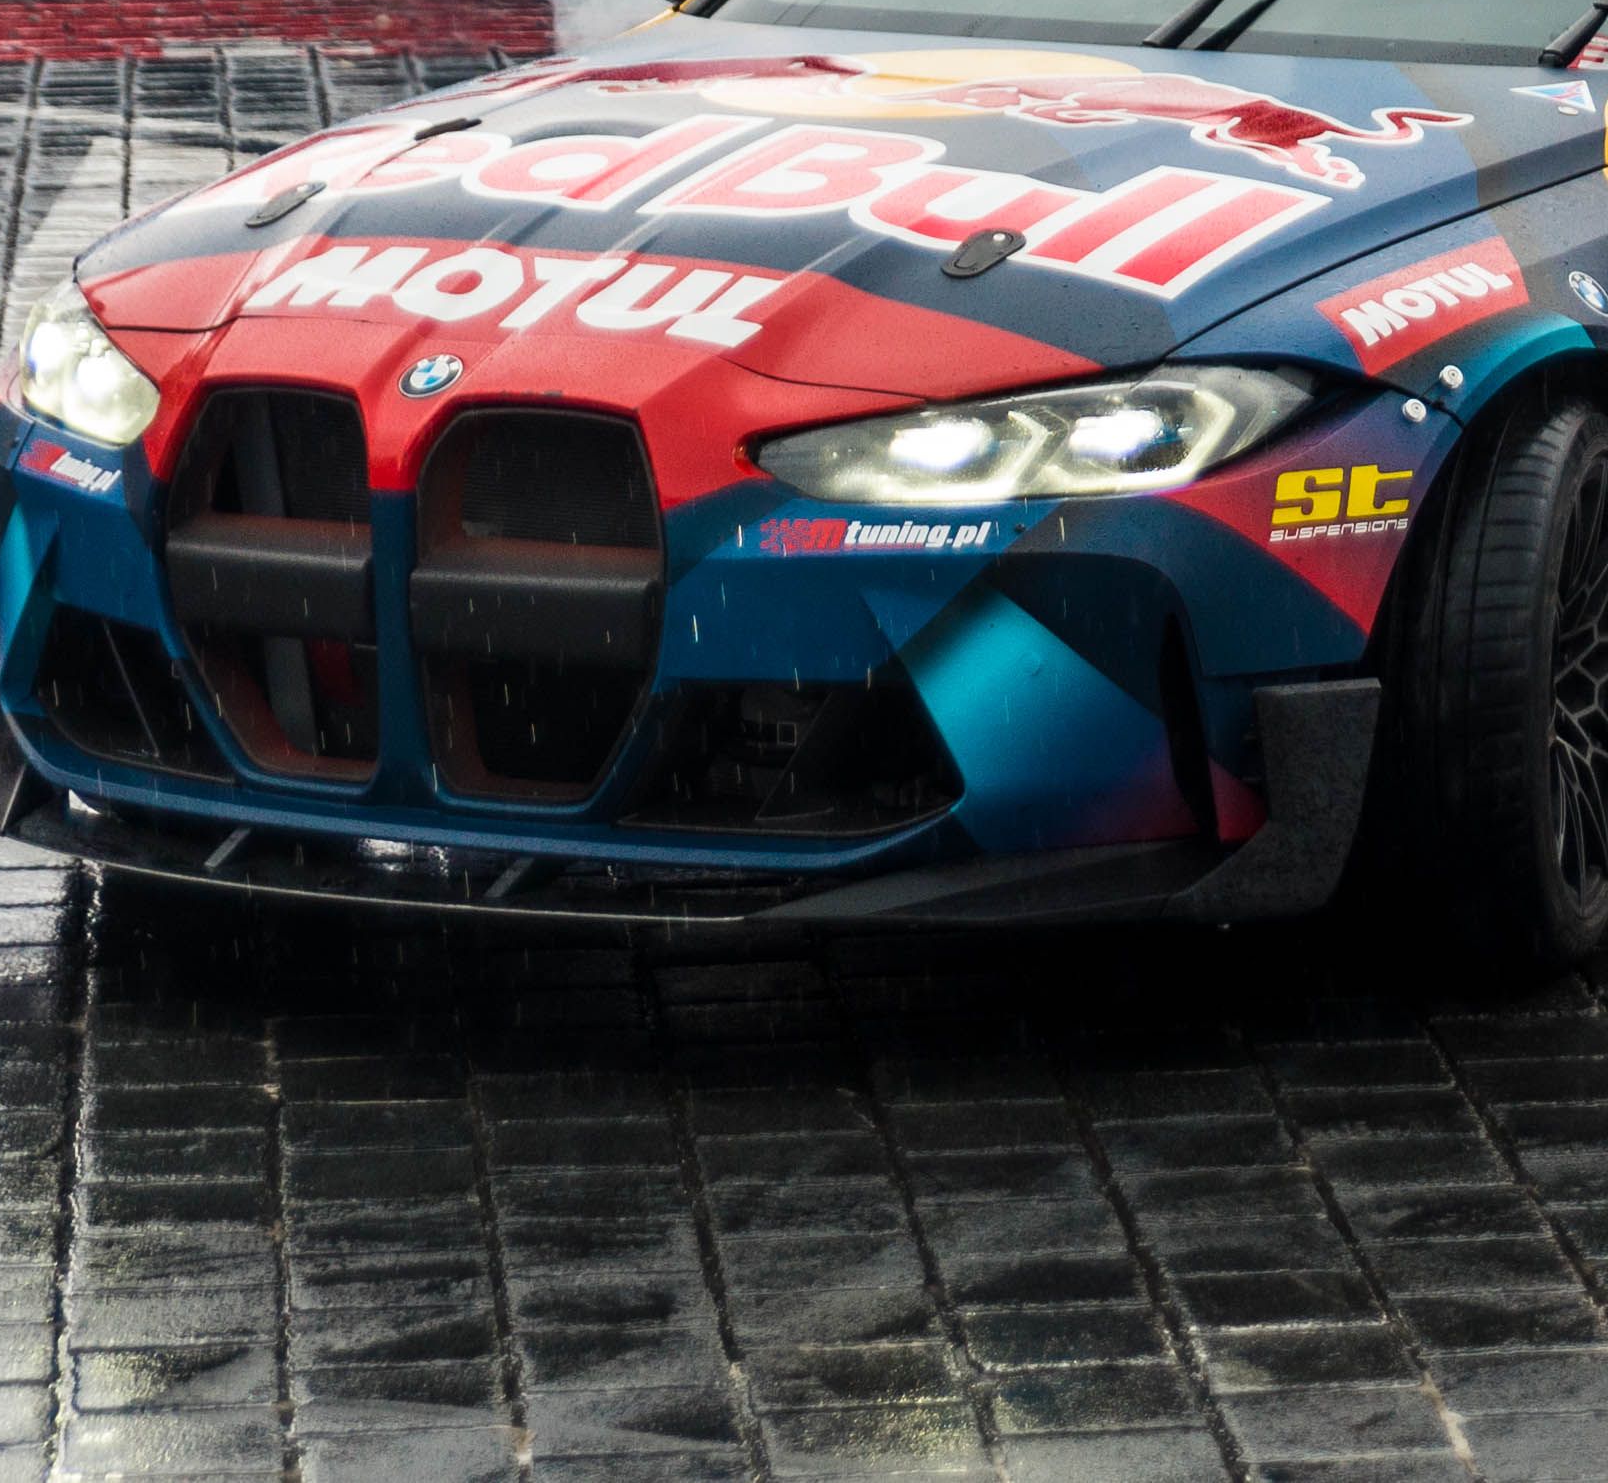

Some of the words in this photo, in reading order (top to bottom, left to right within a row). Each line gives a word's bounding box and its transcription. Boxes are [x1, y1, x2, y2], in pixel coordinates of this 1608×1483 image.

[635, 122, 1334, 300] Bull
[241, 245, 787, 349] MOTUL
[1340, 261, 1513, 347] MOTUL
